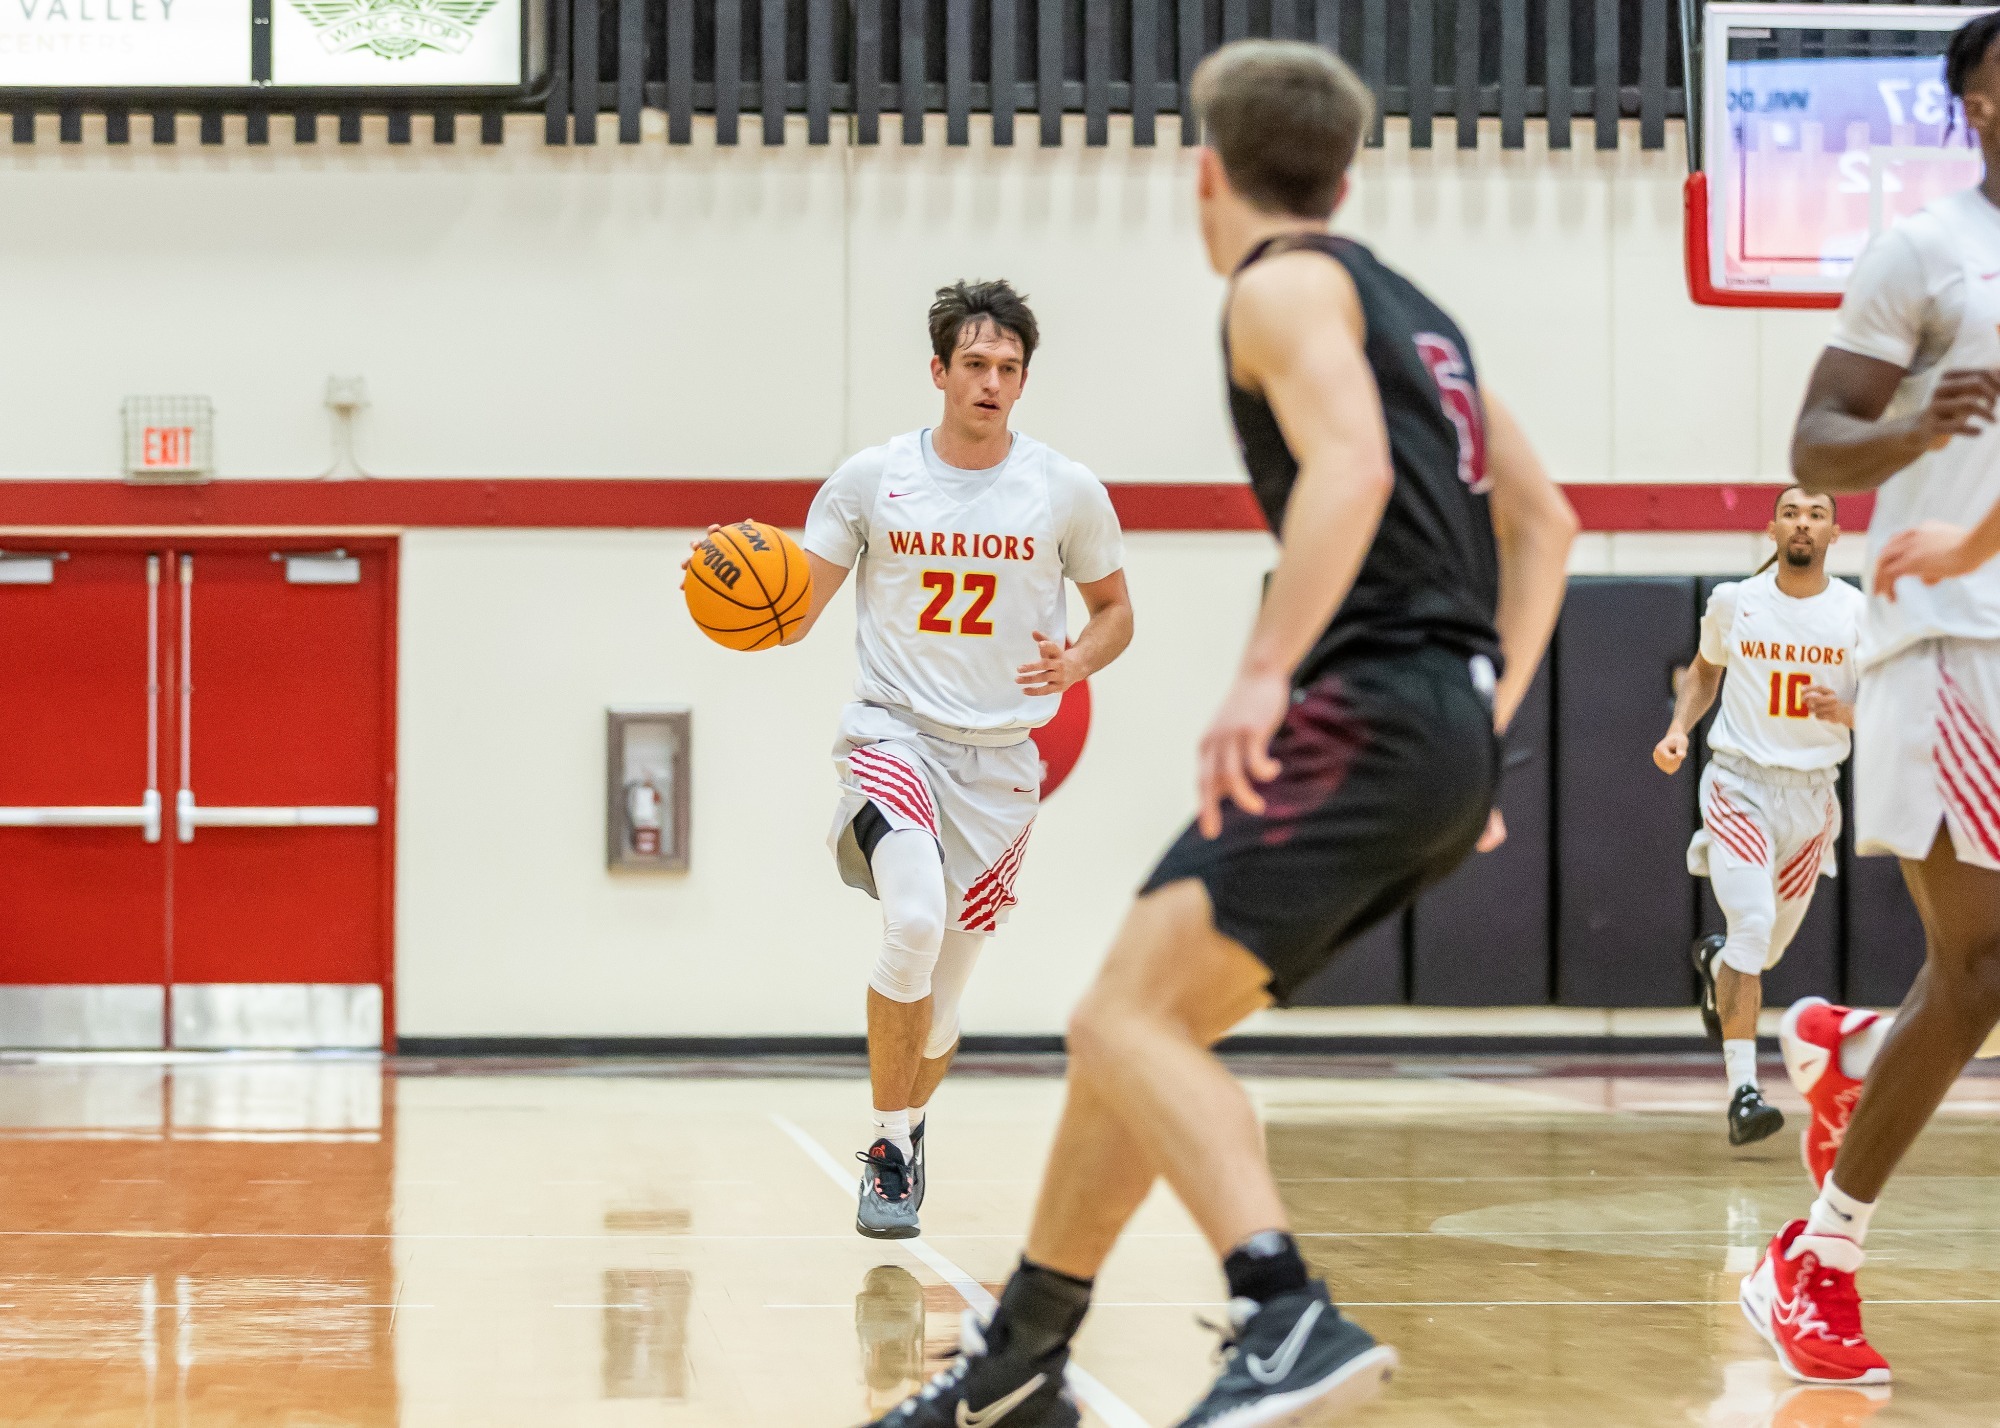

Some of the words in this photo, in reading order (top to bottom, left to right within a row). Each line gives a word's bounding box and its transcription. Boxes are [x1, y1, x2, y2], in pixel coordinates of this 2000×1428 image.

[19, 0, 175, 21] VALLEY
[143, 426, 194, 467] EXIT
[887, 530, 1035, 561] WARRIORS
[918, 570, 997, 636] 22
[1740, 640, 1845, 665] WARRIORS
[1768, 670, 1812, 719] 10
